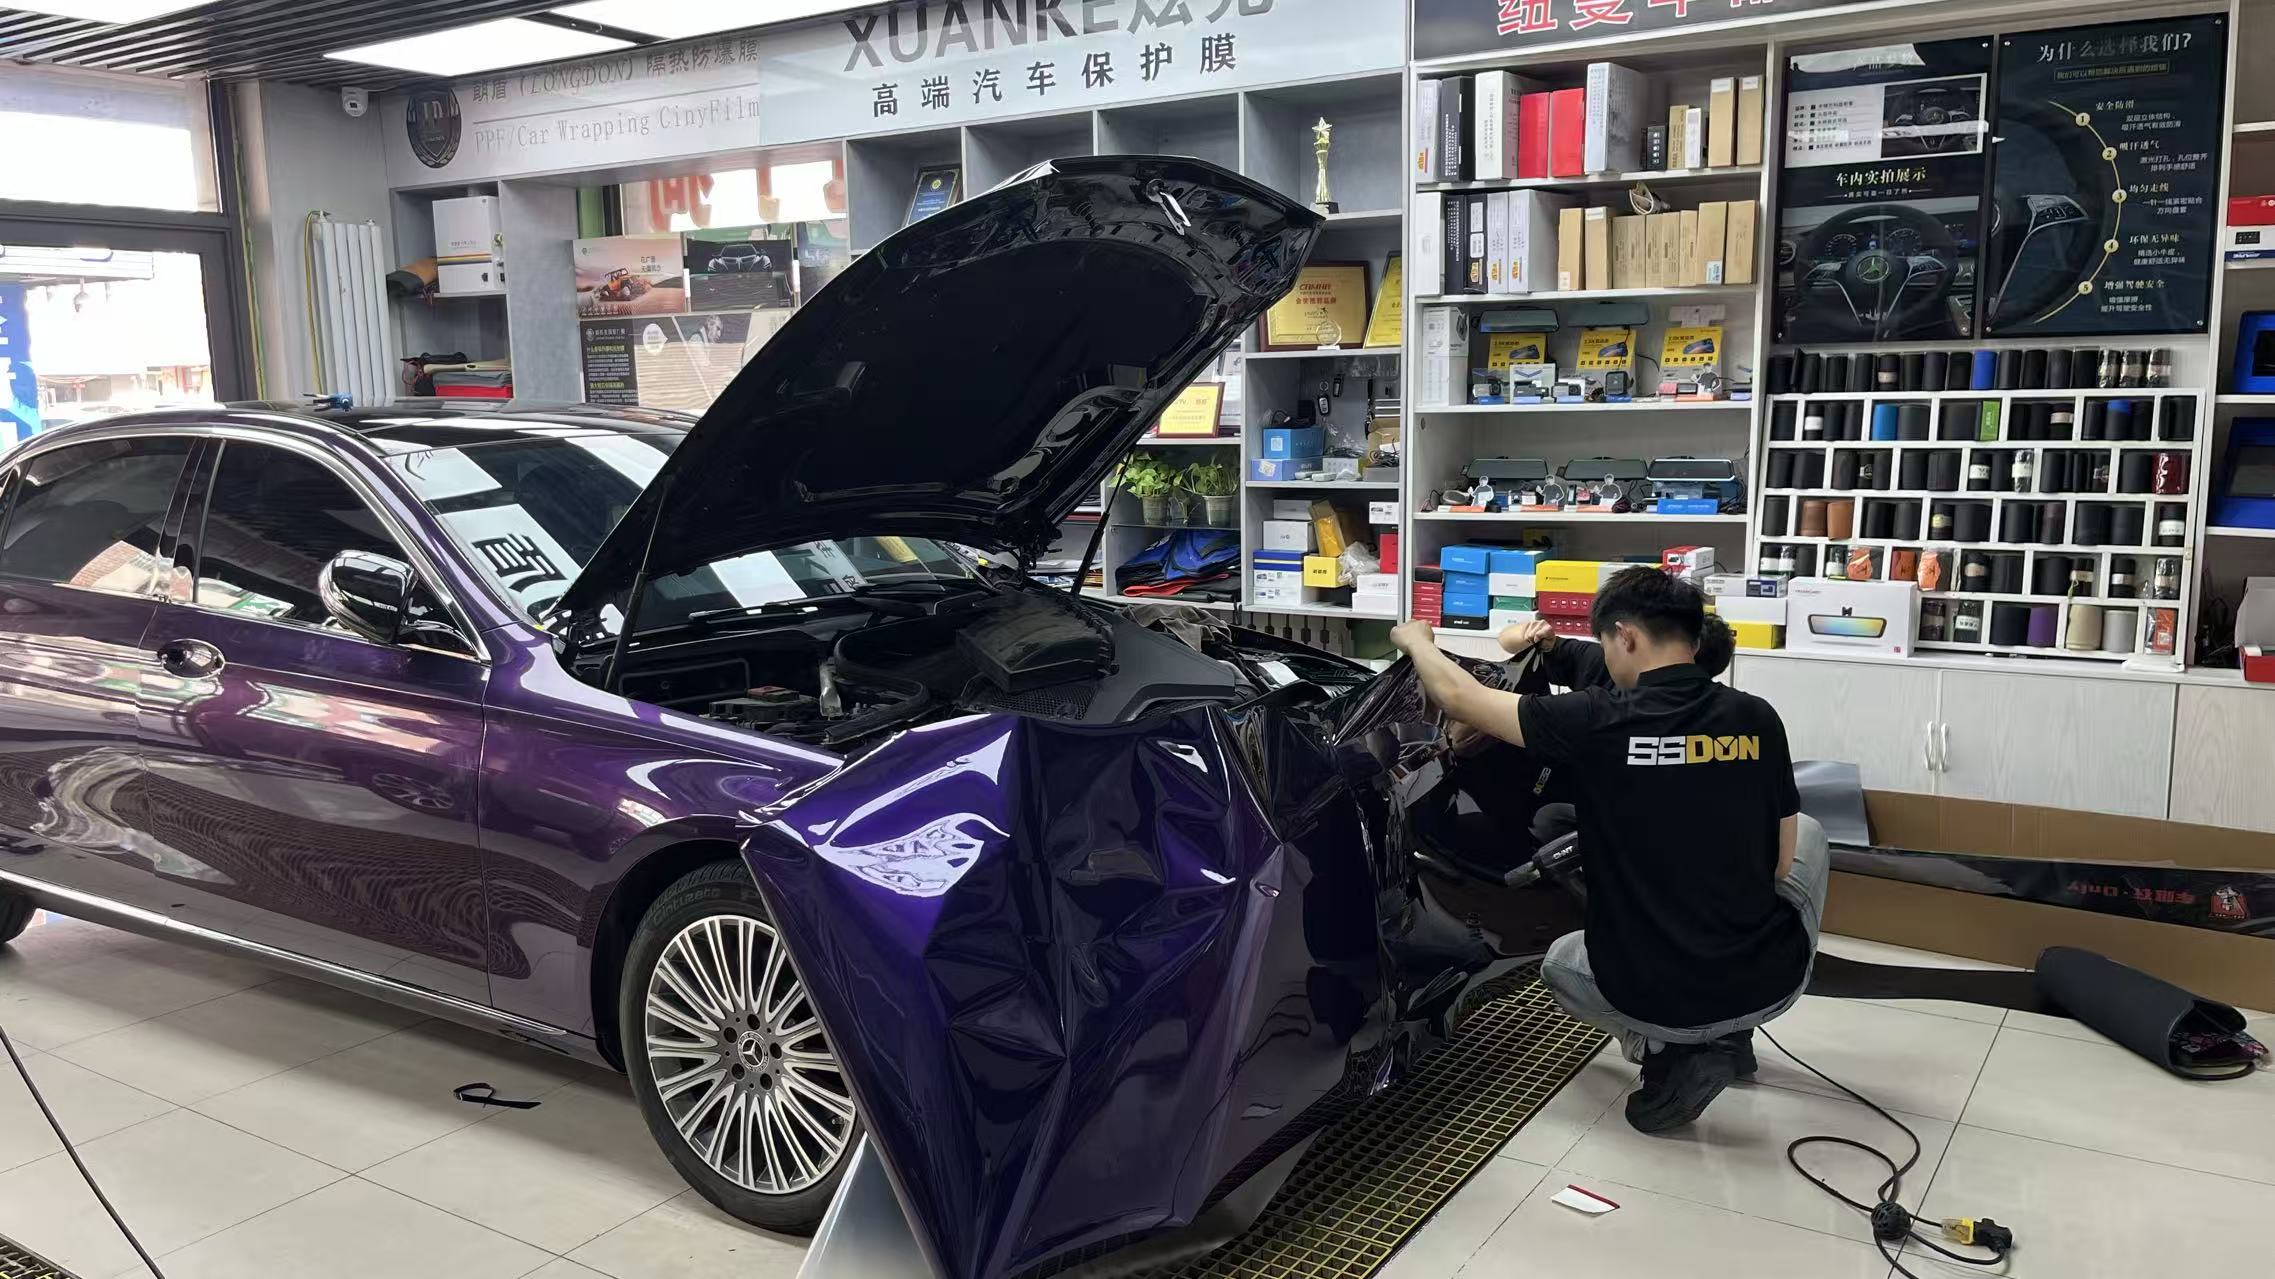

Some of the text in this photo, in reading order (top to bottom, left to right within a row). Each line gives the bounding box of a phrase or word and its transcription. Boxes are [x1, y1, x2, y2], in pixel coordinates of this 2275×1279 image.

[843, 0, 1119, 72] XUANKE
[872, 33, 1236, 117] 高端汽车保护膜
[558, 112, 649, 143] Wrapping
[1836, 166, 1926, 187] 车内实拍展示
[1627, 734, 1760, 766] SSDON
